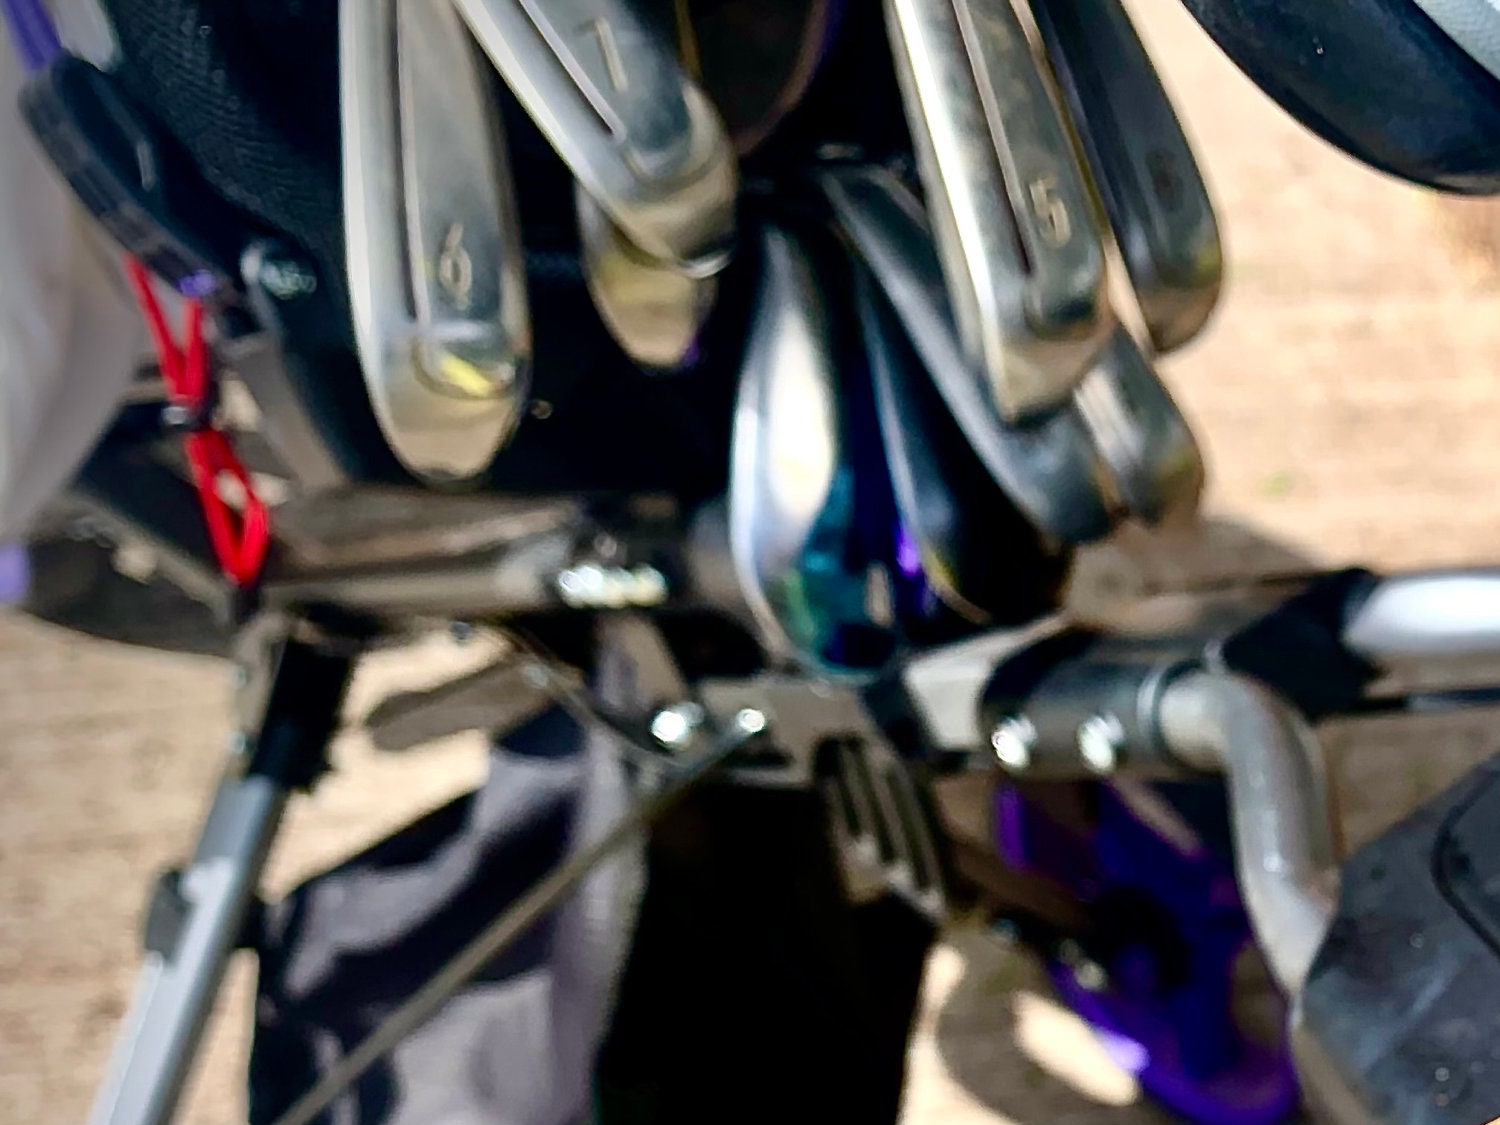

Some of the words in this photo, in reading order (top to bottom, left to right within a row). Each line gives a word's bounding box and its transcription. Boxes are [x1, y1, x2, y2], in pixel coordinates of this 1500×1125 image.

[572, 17, 629, 92] 7
[1028, 172, 1071, 249] 5
[439, 221, 472, 309] 6
